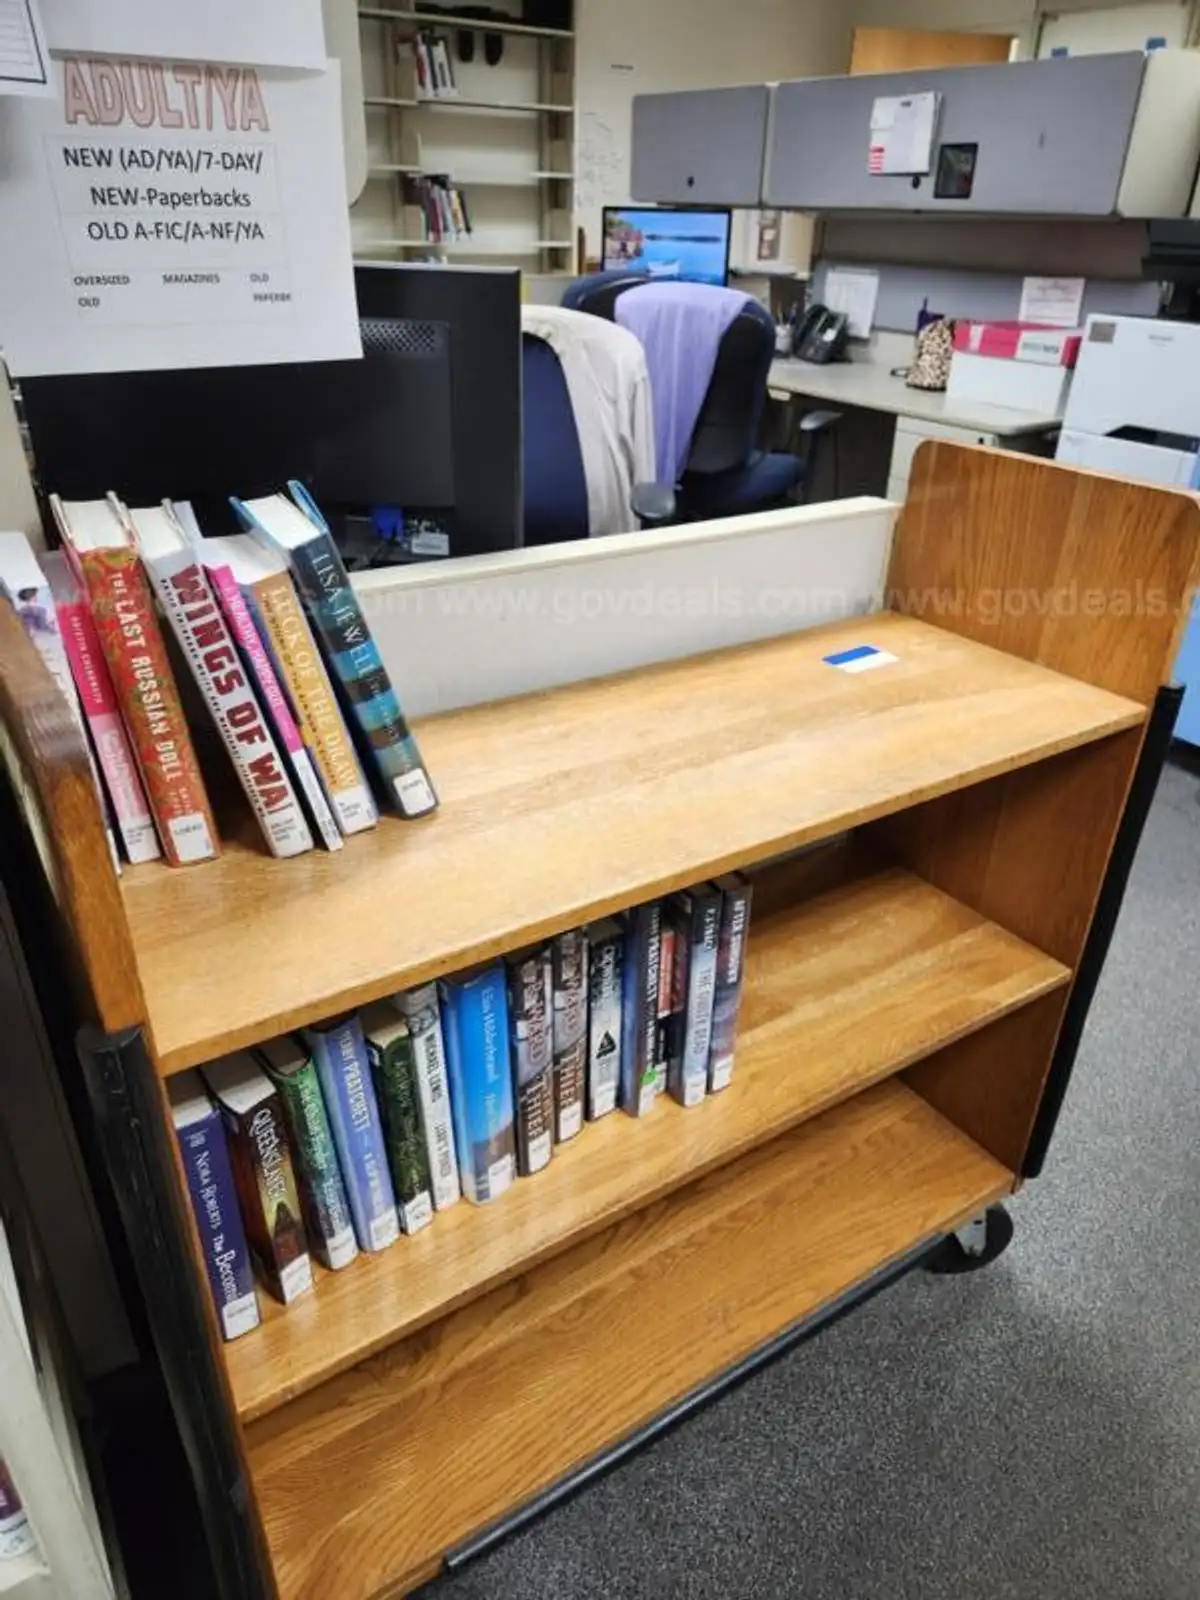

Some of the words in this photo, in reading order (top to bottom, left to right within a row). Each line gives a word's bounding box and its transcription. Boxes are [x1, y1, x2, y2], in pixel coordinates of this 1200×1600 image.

[63, 59, 270, 132] ADULT/YA
[63, 148, 113, 168] NEW
[119, 149, 263, 174] (AD/YA)/7-DAY/
[90, 187, 251, 209] NEW-Paperbacks
[87, 222, 129, 241] OLD
[134, 222, 264, 244] A-FIC/A-NF/YA
[73, 275, 130, 286] OVERSIZED
[112, 573, 128, 594] THE
[116, 600, 146, 647] LAST
[269, 586, 303, 650] LUCK
[312, 554, 343, 602] LISA
[332, 606, 376, 676] JEWELL
[294, 650, 319, 682] OF
[131, 656, 171, 735] RUSSIAN
[170, 564, 245, 695] WINGS
[226, 701, 267, 745] OF
[248, 752, 294, 814] WA
[306, 687, 340, 728] THE
[155, 740, 183, 782] DOLL
[326, 731, 357, 787] DRAW
[425, 1033, 441, 1075] MICHAEL
[343, 1062, 371, 1132] PRATCHETT
[527, 1076, 546, 1138] THIEF
